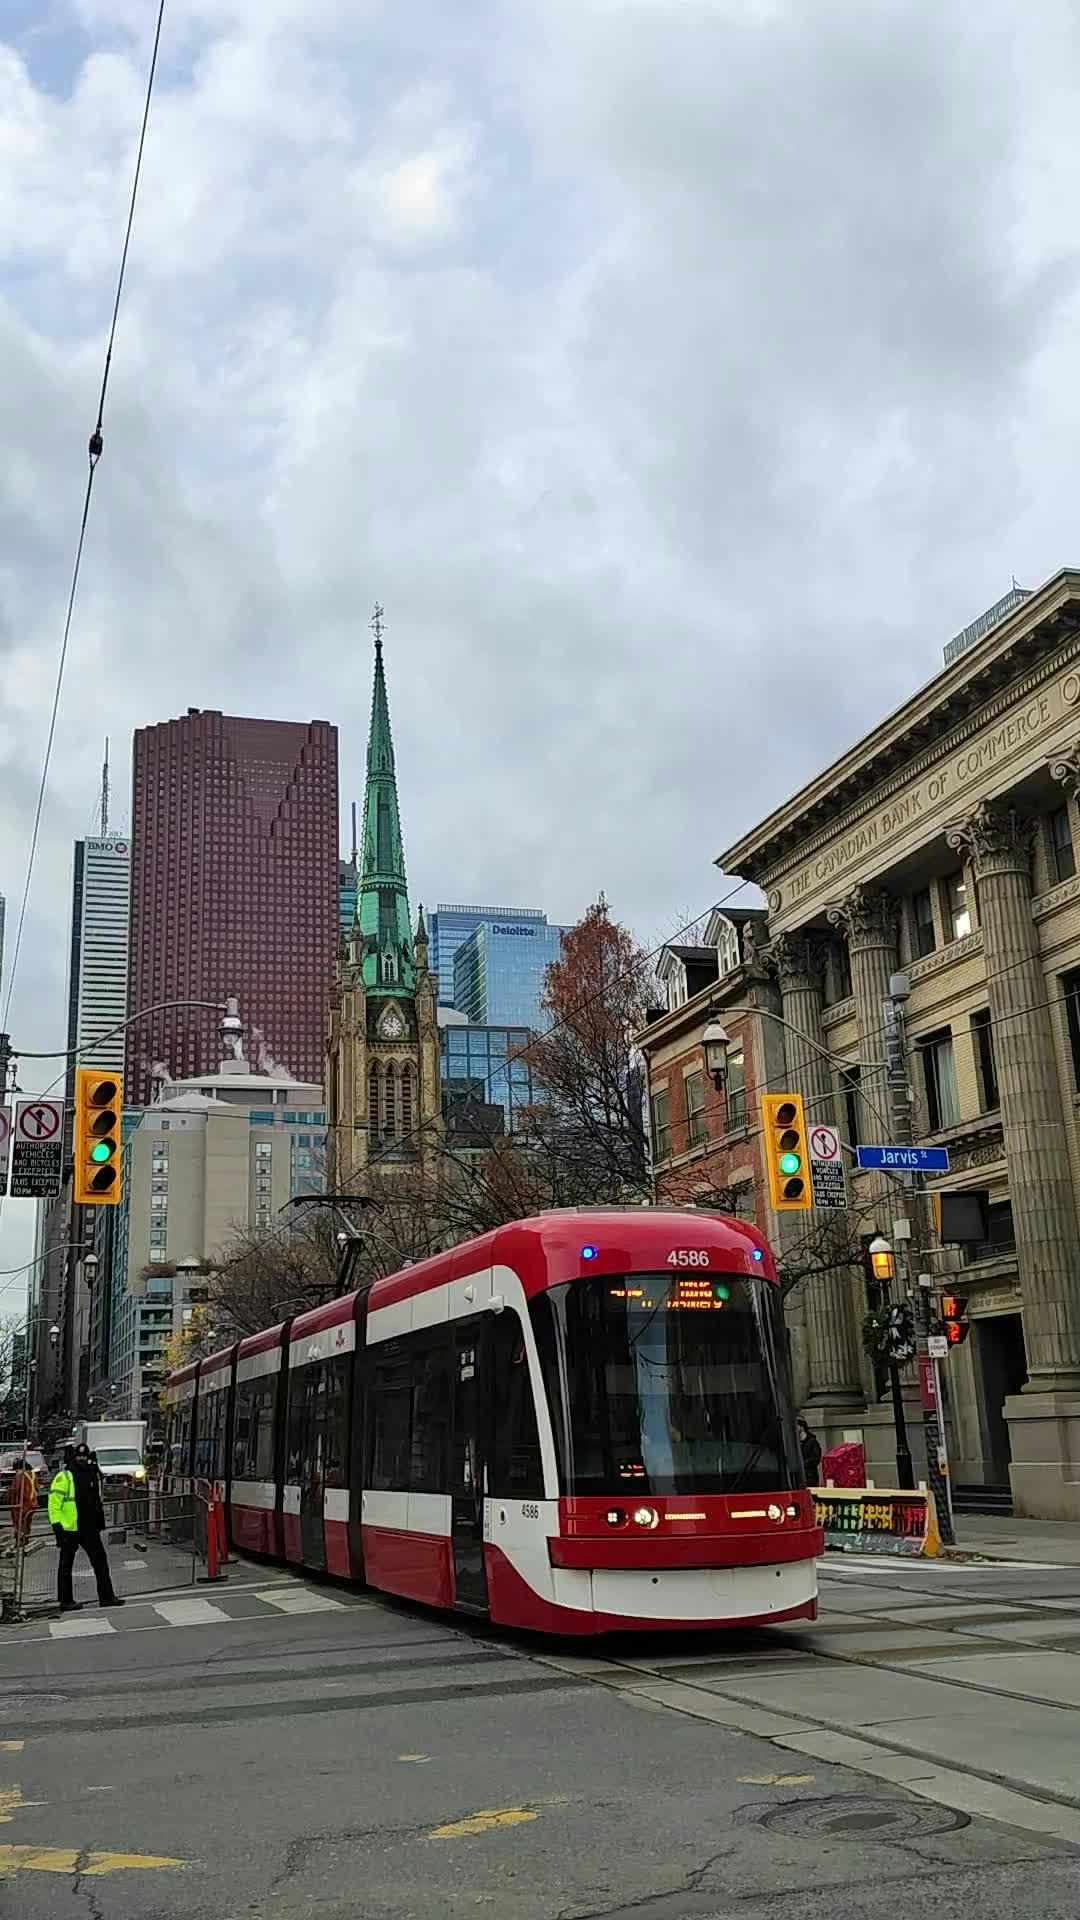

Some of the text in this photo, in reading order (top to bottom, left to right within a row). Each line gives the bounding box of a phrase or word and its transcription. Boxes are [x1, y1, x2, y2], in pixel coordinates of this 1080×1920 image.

[787, 696, 1051, 898] THE CANADIAN BANK OF COMMERCE
[88, 842, 113, 851] BMO
[21, 1151, 55, 1159] VEHICLES
[880, 1149, 919, 1165] Jarvis
[14, 1159, 60, 1167] AND BICYCLES
[667, 1250, 710, 1266] 4586
[521, 1504, 539, 1519] 4586
